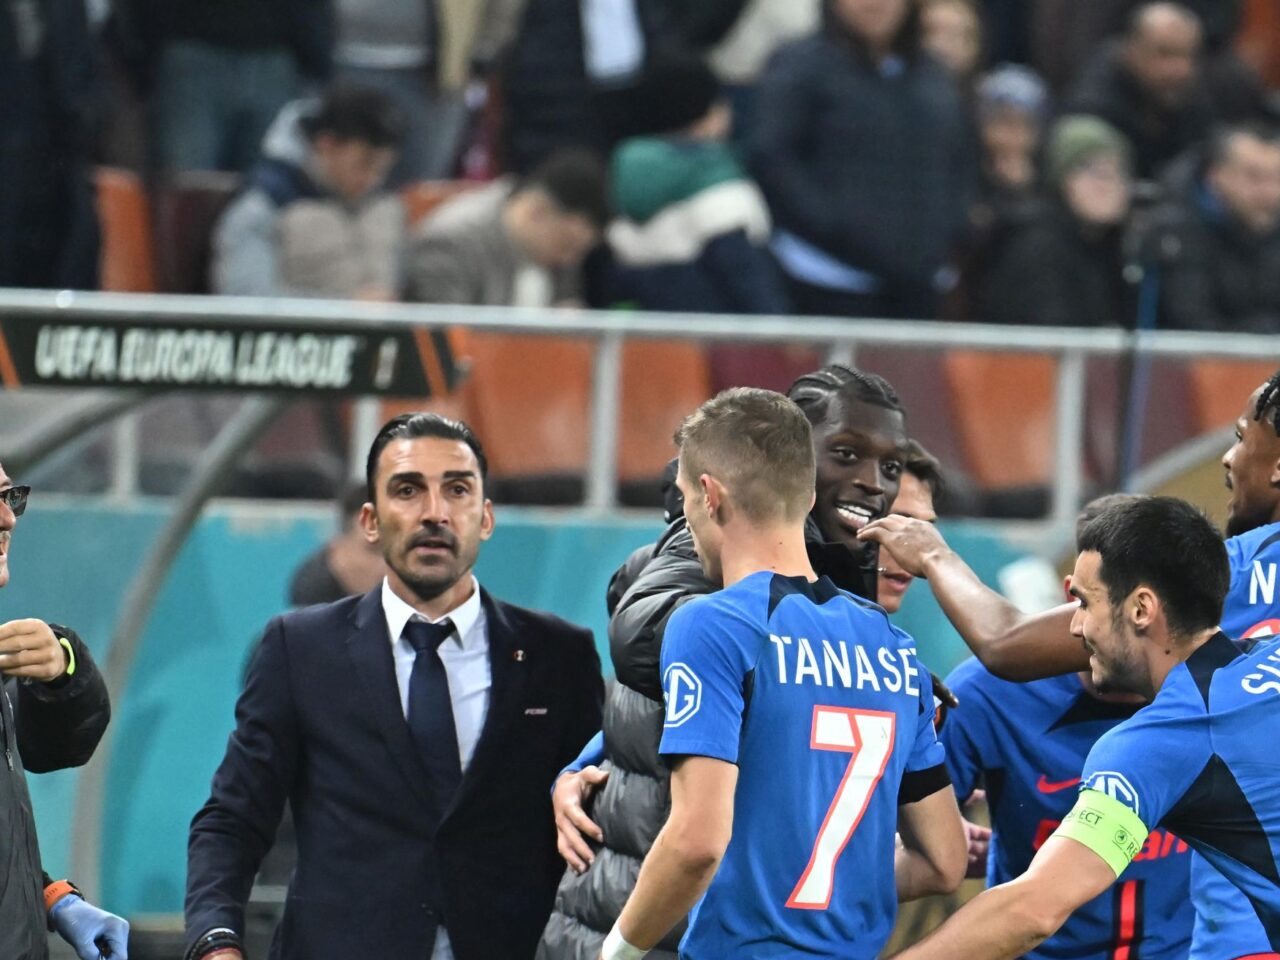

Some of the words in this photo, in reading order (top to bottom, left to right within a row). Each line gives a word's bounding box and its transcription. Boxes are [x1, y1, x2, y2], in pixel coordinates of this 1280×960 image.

[35, 324, 118, 378] UEFA
[118, 327, 235, 384] EUROPA
[235, 331, 355, 388] LEAGUE
[769, 633, 920, 698] TANASE
[784, 704, 897, 910] 7
